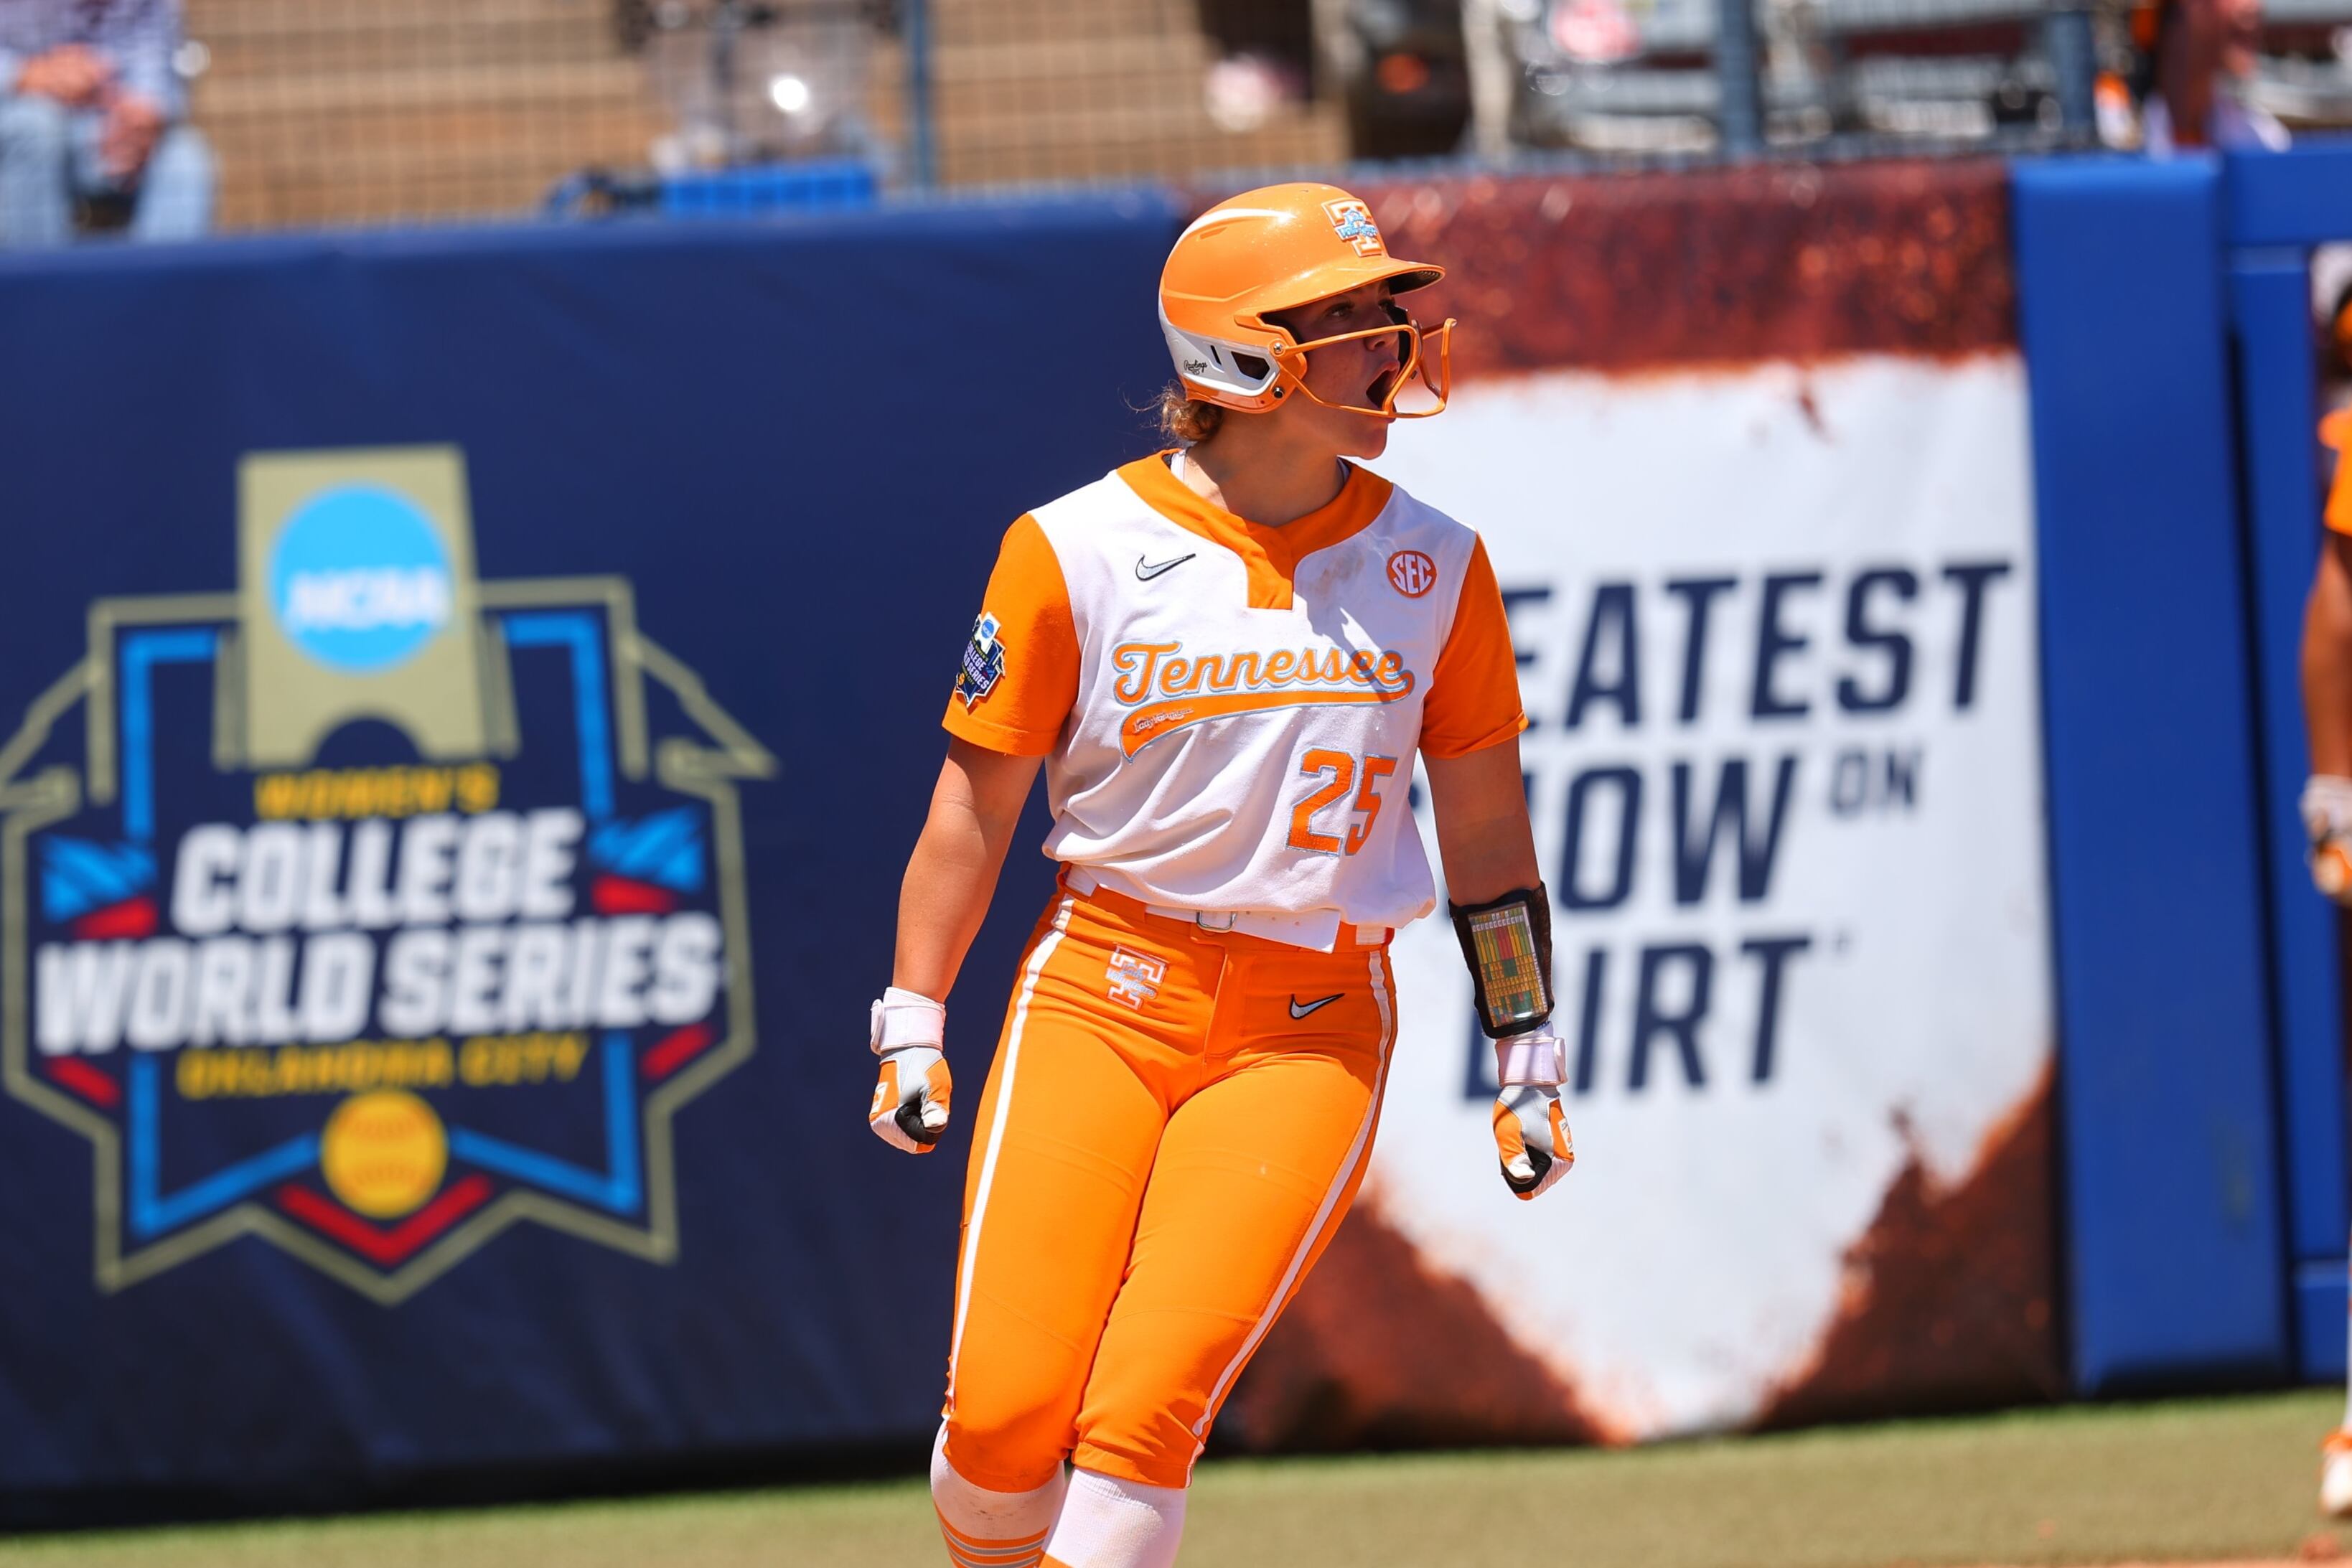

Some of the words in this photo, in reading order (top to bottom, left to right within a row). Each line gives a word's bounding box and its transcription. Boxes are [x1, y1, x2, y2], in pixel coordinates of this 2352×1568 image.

[1391, 553, 1433, 594] SEC
[1112, 639, 1408, 707] Tennessee
[1285, 746, 1398, 856] 25
[1830, 745, 1921, 817] ON
[170, 807, 586, 937] COLLEGE
[34, 933, 378, 1056] WORLD
[376, 912, 723, 1040] SERIES
[458, 1031, 590, 1087] CITY
